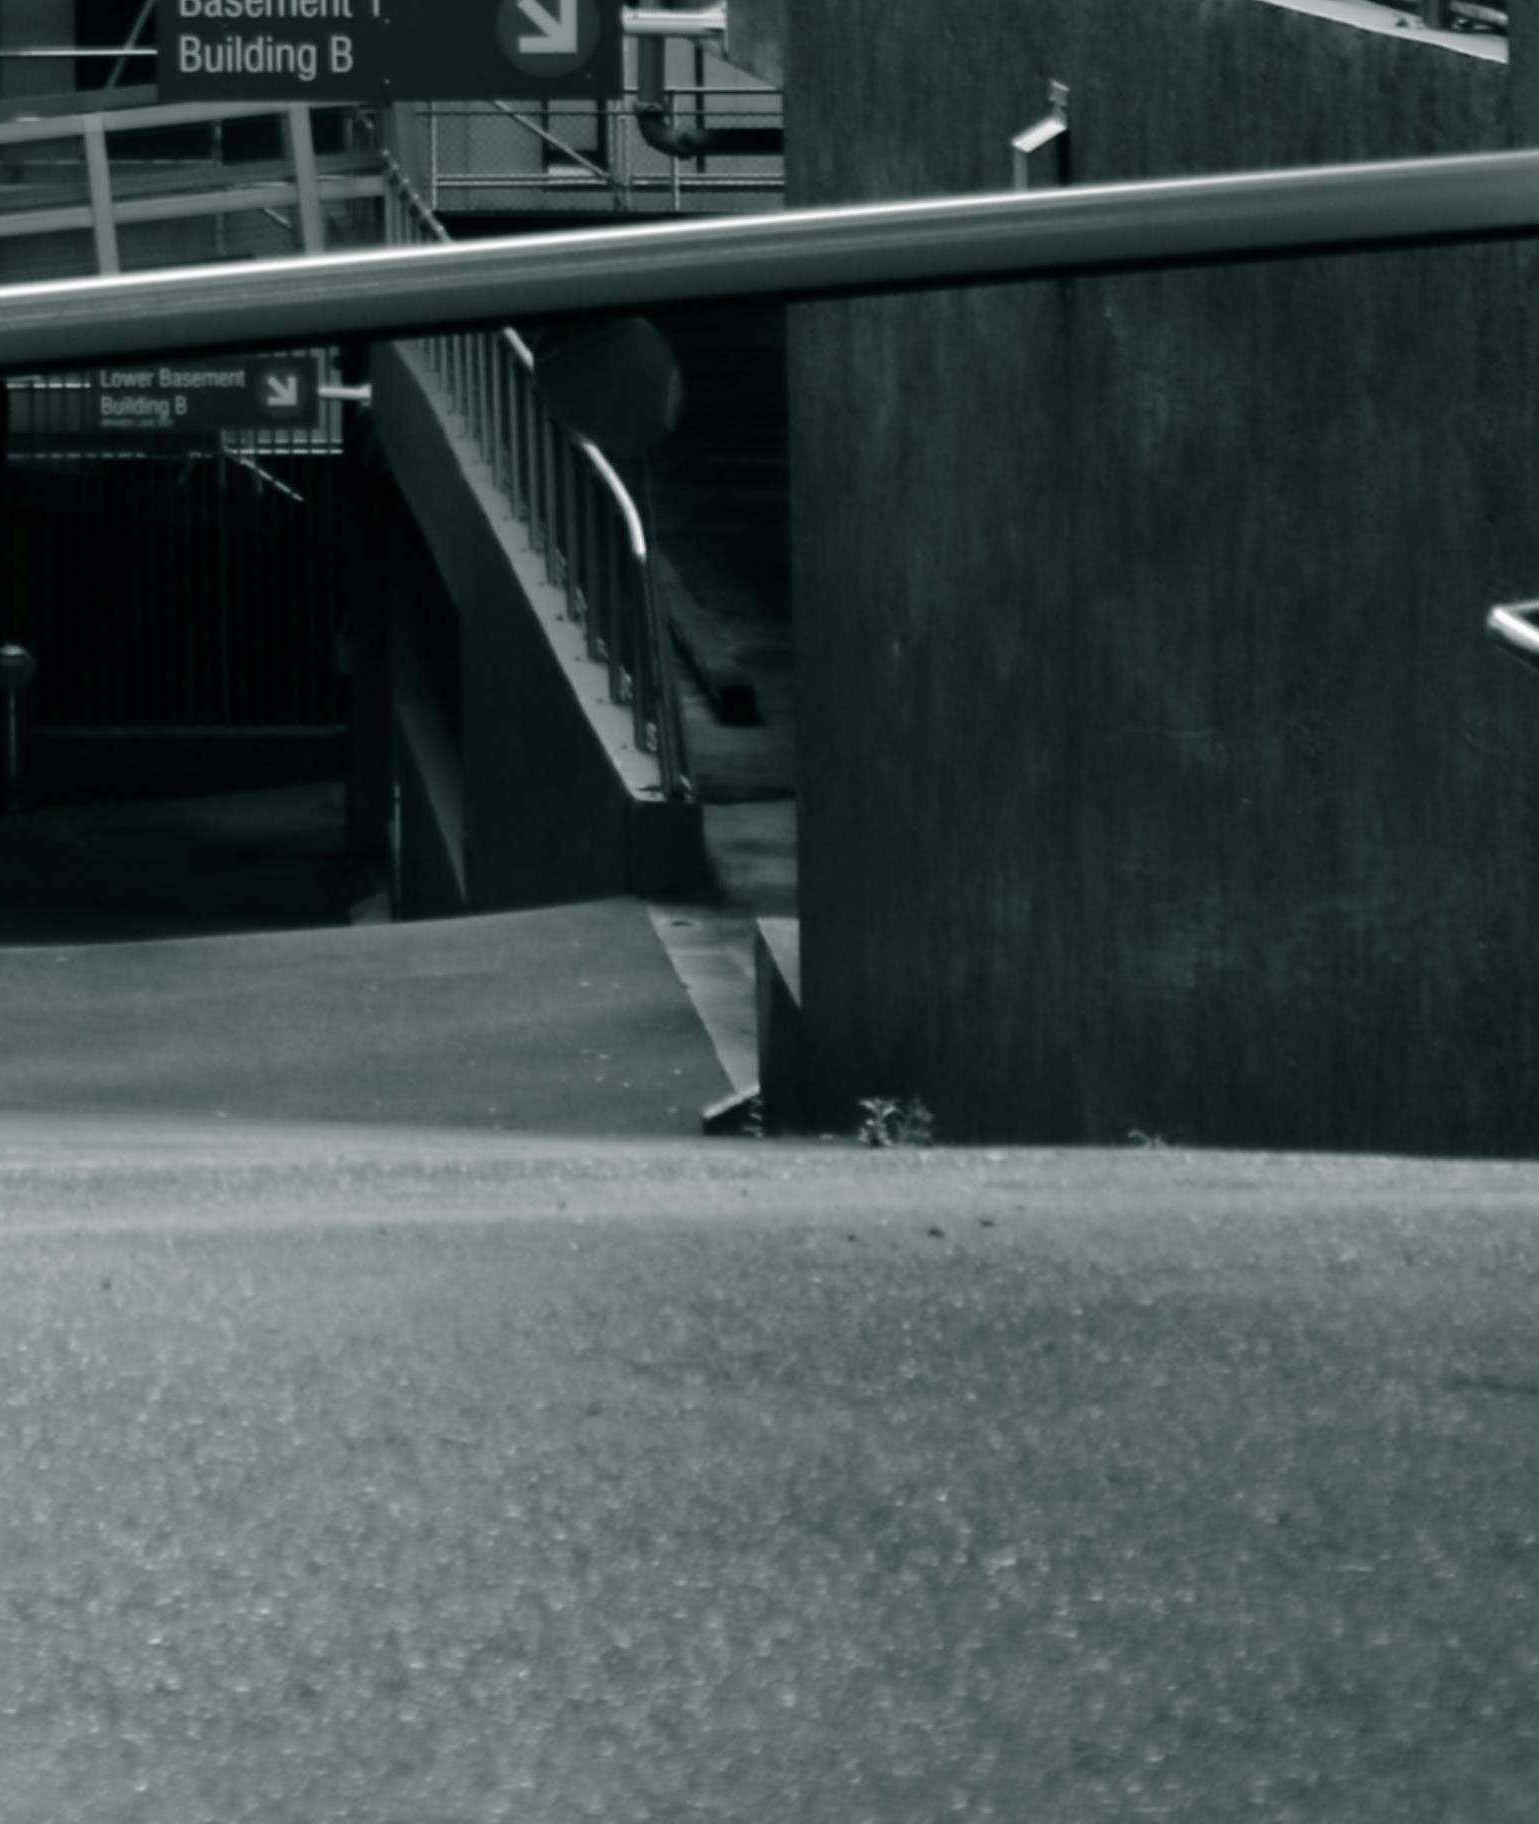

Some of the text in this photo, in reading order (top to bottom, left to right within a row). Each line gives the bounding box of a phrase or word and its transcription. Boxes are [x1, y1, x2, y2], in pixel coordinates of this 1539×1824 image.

[179, 34, 354, 82] Building B
[99, 367, 246, 388] Lower Basement
[100, 394, 188, 419] Building B
